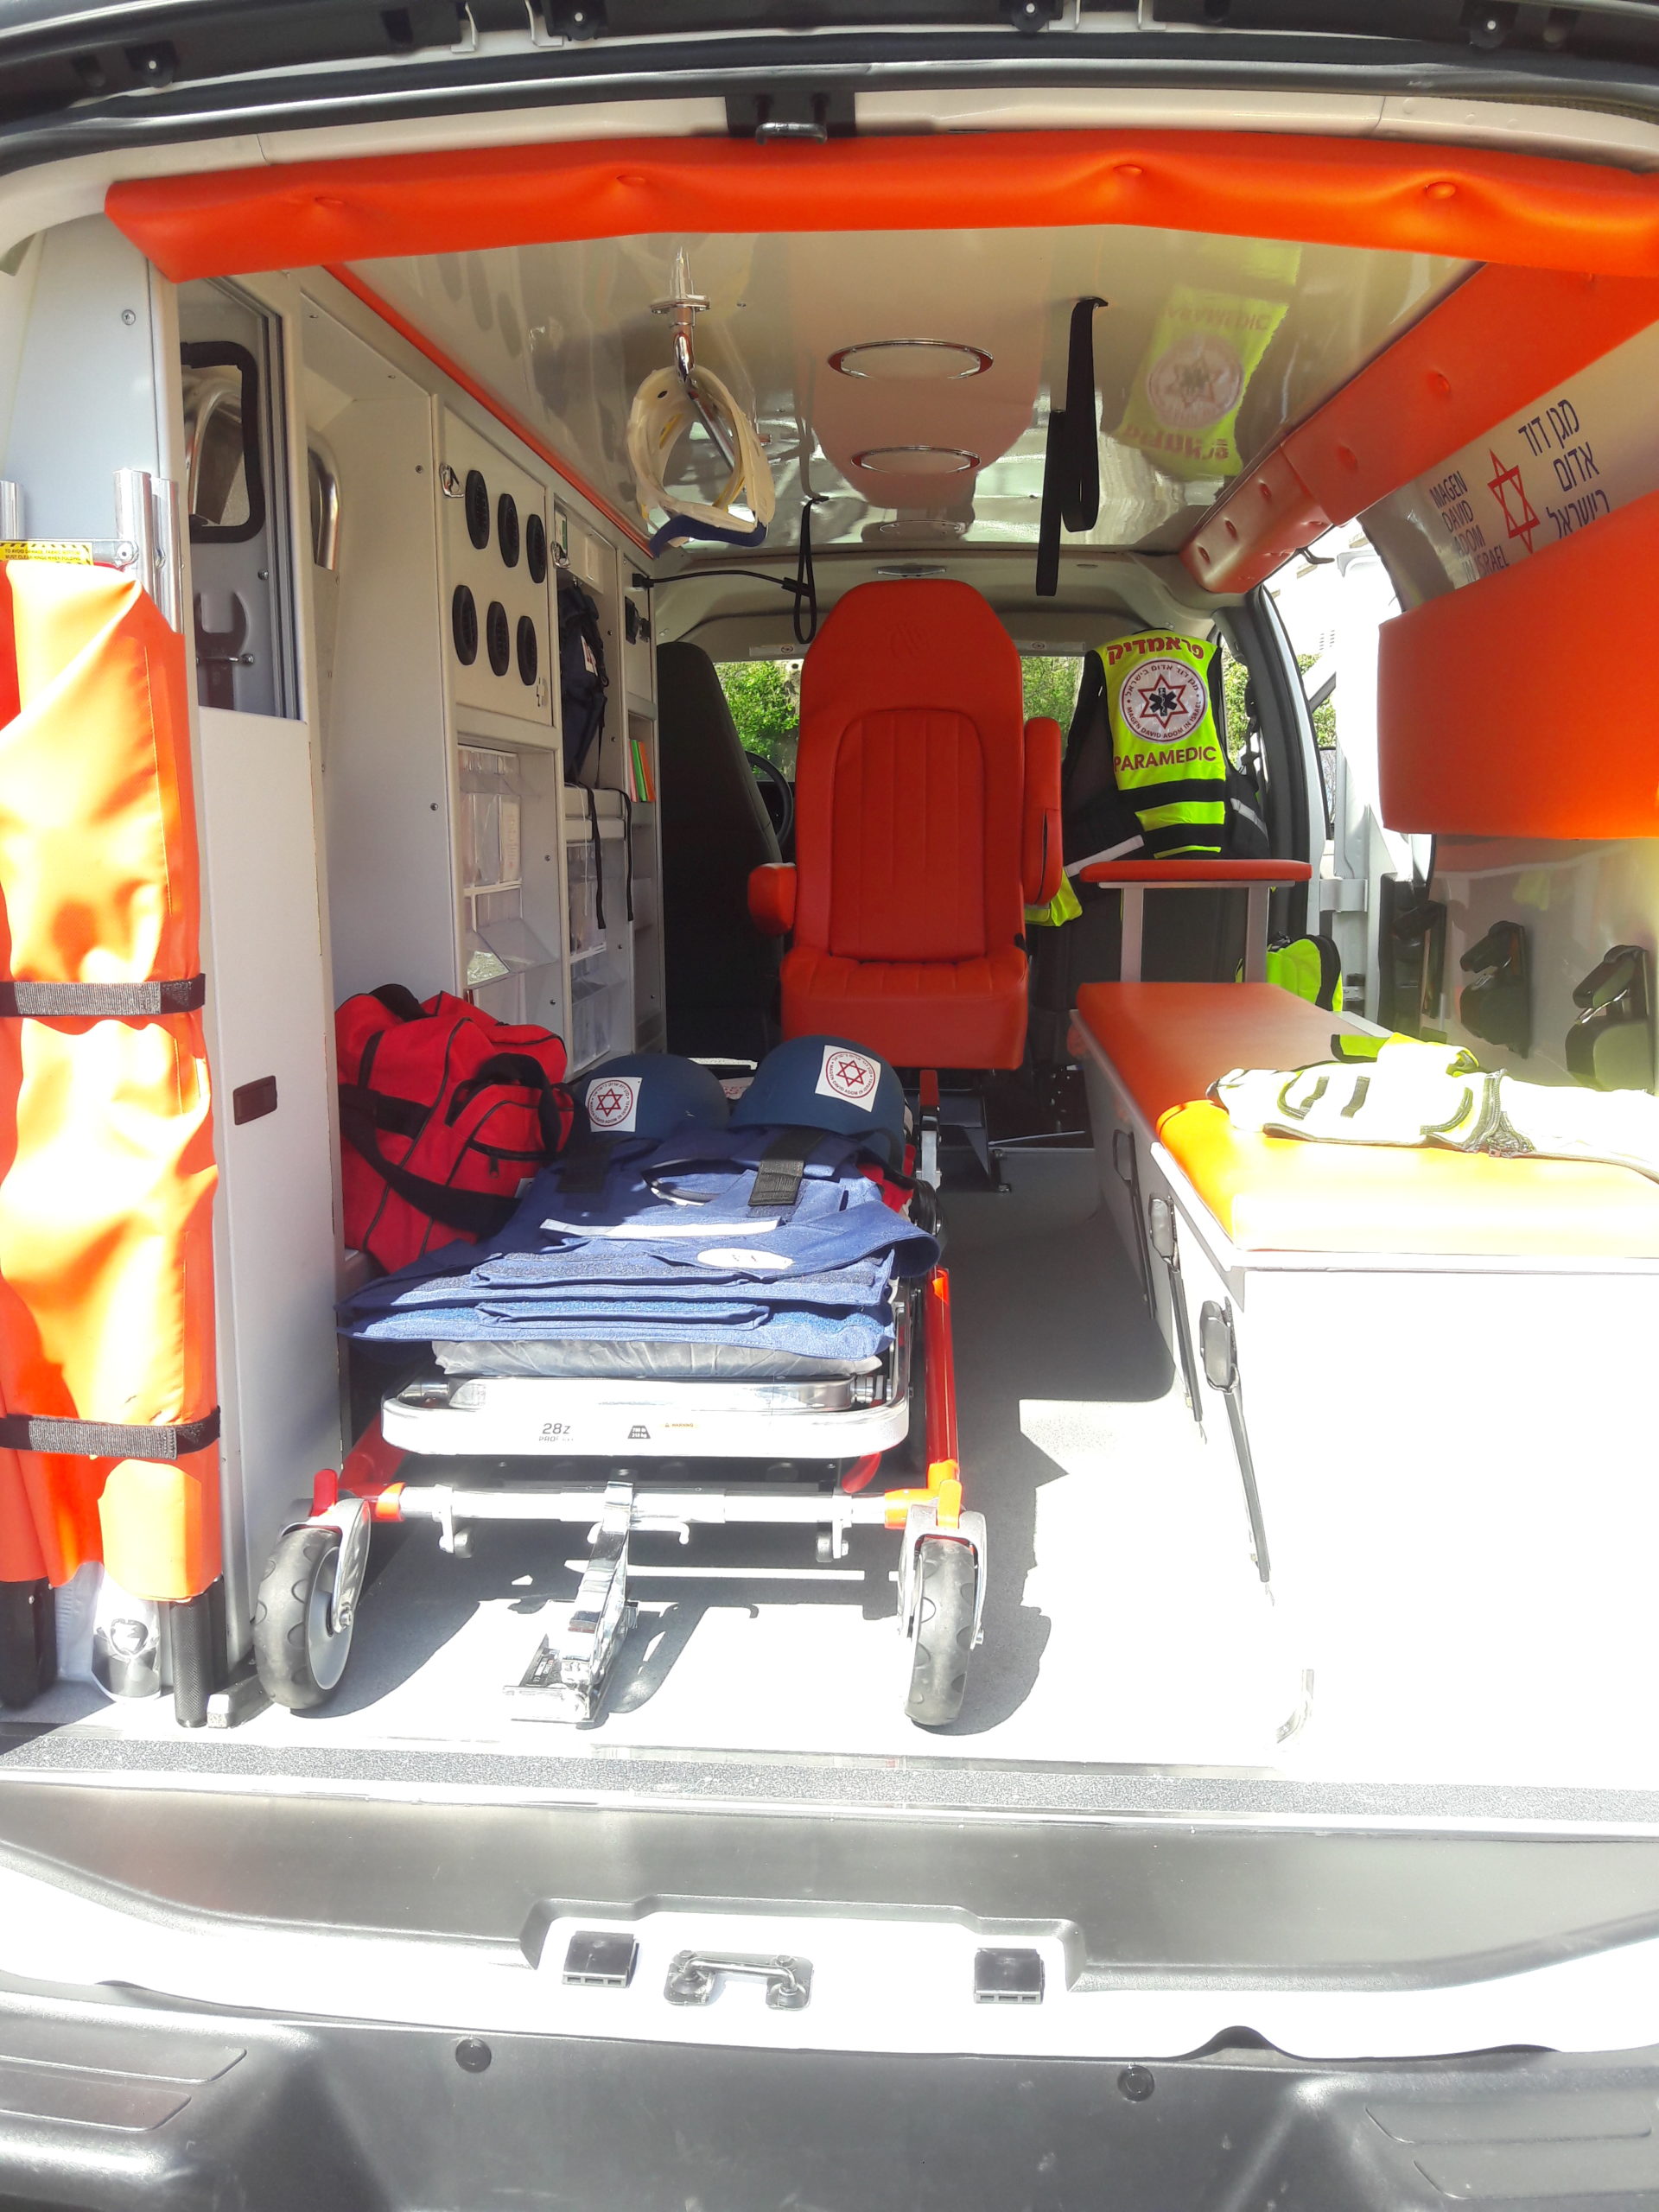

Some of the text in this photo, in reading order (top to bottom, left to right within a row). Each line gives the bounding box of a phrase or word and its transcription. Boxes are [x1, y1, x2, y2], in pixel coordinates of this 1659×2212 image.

[1517, 399, 1580, 457] מגן דוד
[1553, 442, 1600, 493] אדום
[1429, 471, 1468, 509] MAGEN
[1441, 499, 1473, 533] DAVID
[1454, 524, 1486, 556] ADOM
[1477, 544, 1510, 577] ISRAEL
[1107, 636, 1205, 665] פראמדיק
[1124, 668, 1149, 696] בישראל
[1176, 666, 1189, 677] דוד
[1187, 677, 1199, 692] מגן
[1126, 706, 1141, 730] MAGEN
[1141, 728, 1161, 739] DAVID
[1162, 727, 1184, 739] ADOM
[1190, 700, 1201, 727] ISRAEL
[1113, 747, 1217, 772] PARAMEDIC
